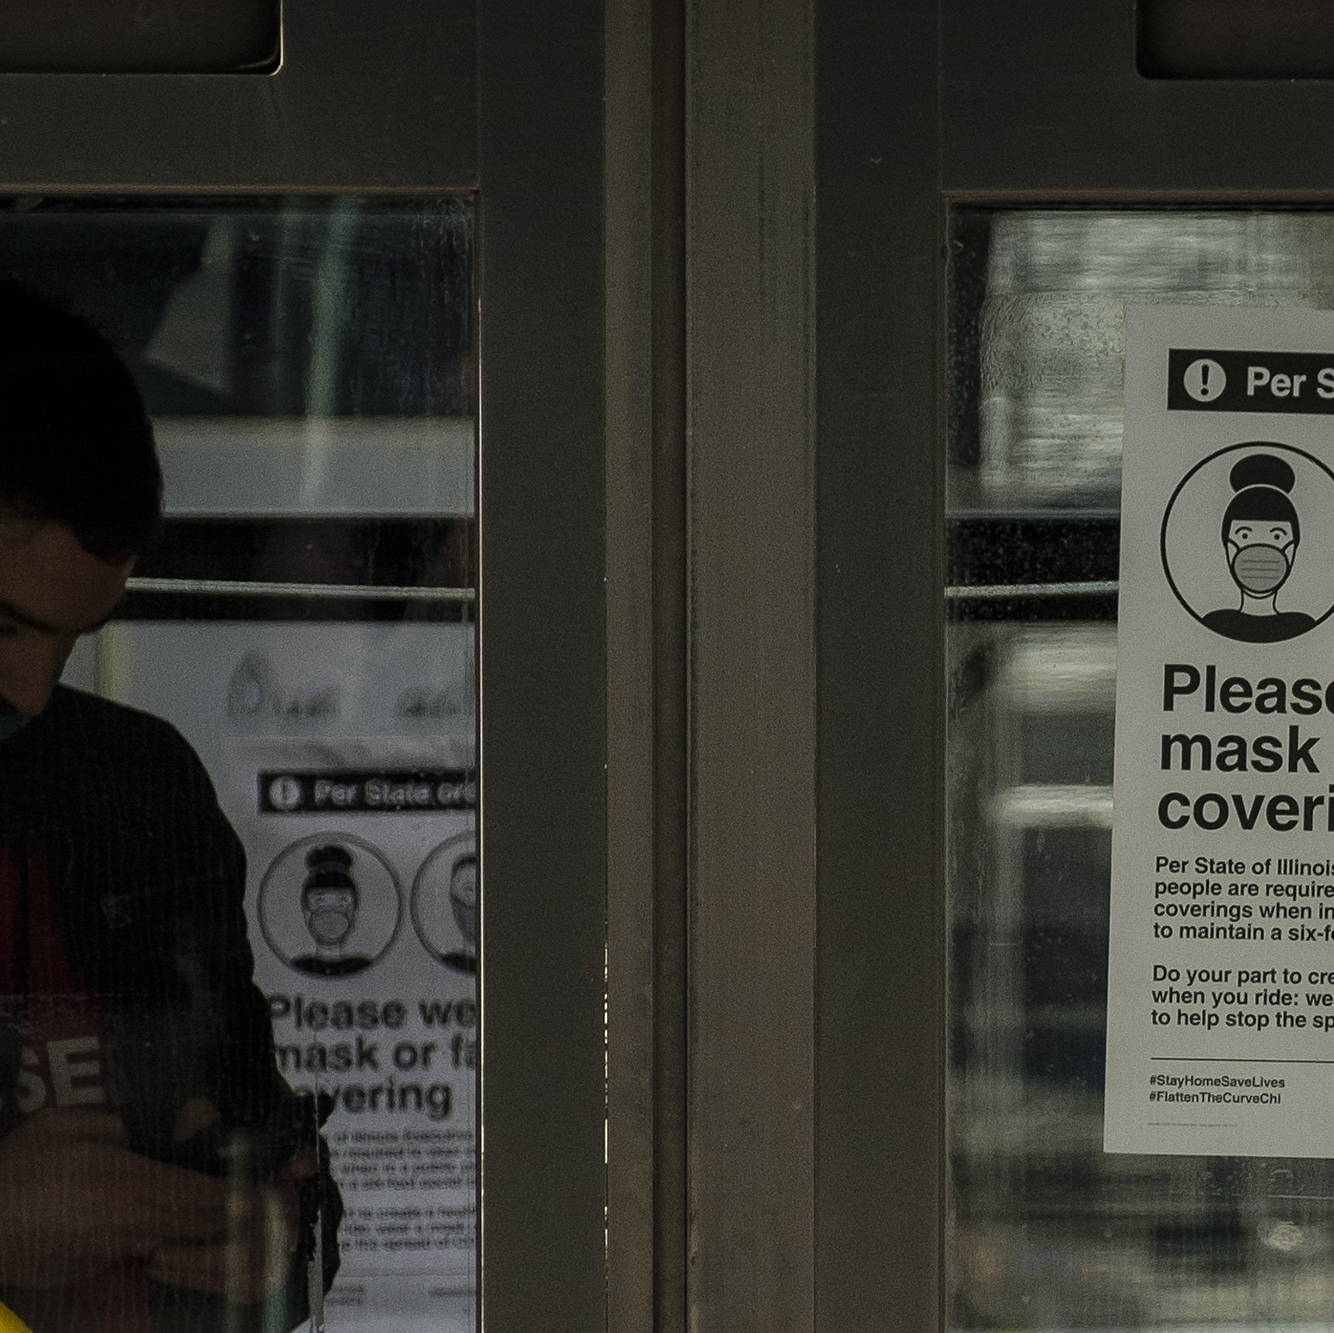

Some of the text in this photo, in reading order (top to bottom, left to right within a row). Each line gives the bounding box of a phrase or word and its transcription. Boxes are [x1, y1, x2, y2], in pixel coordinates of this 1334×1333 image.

[1247, 367, 1306, 397] Per
[1161, 725, 1320, 773] mask
[1156, 857, 1188, 873] Per
[1195, 857, 1245, 874] State
[1252, 859, 1271, 874] of
[1155, 879, 1222, 899] people
[1228, 883, 1259, 896] are
[1154, 901, 1252, 922] coverings
[1259, 902, 1311, 919] when
[1319, 903, 1334, 919] in
[1154, 923, 1172, 938] to
[1180, 923, 1264, 940] maintain
[1271, 928, 1281, 940] a
[1154, 965, 1180, 981] Do
[1187, 970, 1232, 986] your
[1238, 969, 1276, 987] part
[1283, 969, 1302, 984] to
[1152, 987, 1204, 1003] when
[1212, 992, 1247, 1008] you
[1256, 989, 1298, 1005] ride:
[270, 994, 407, 1029] Please
[1151, 1010, 1170, 1025] to
[1178, 1009, 1219, 1030] help
[1226, 1011, 1269, 1031] stop
[1276, 1011, 1306, 1028] the
[393, 1043, 439, 1069] or
[1150, 1075, 1285, 1088] #StayHomeSaveLives
